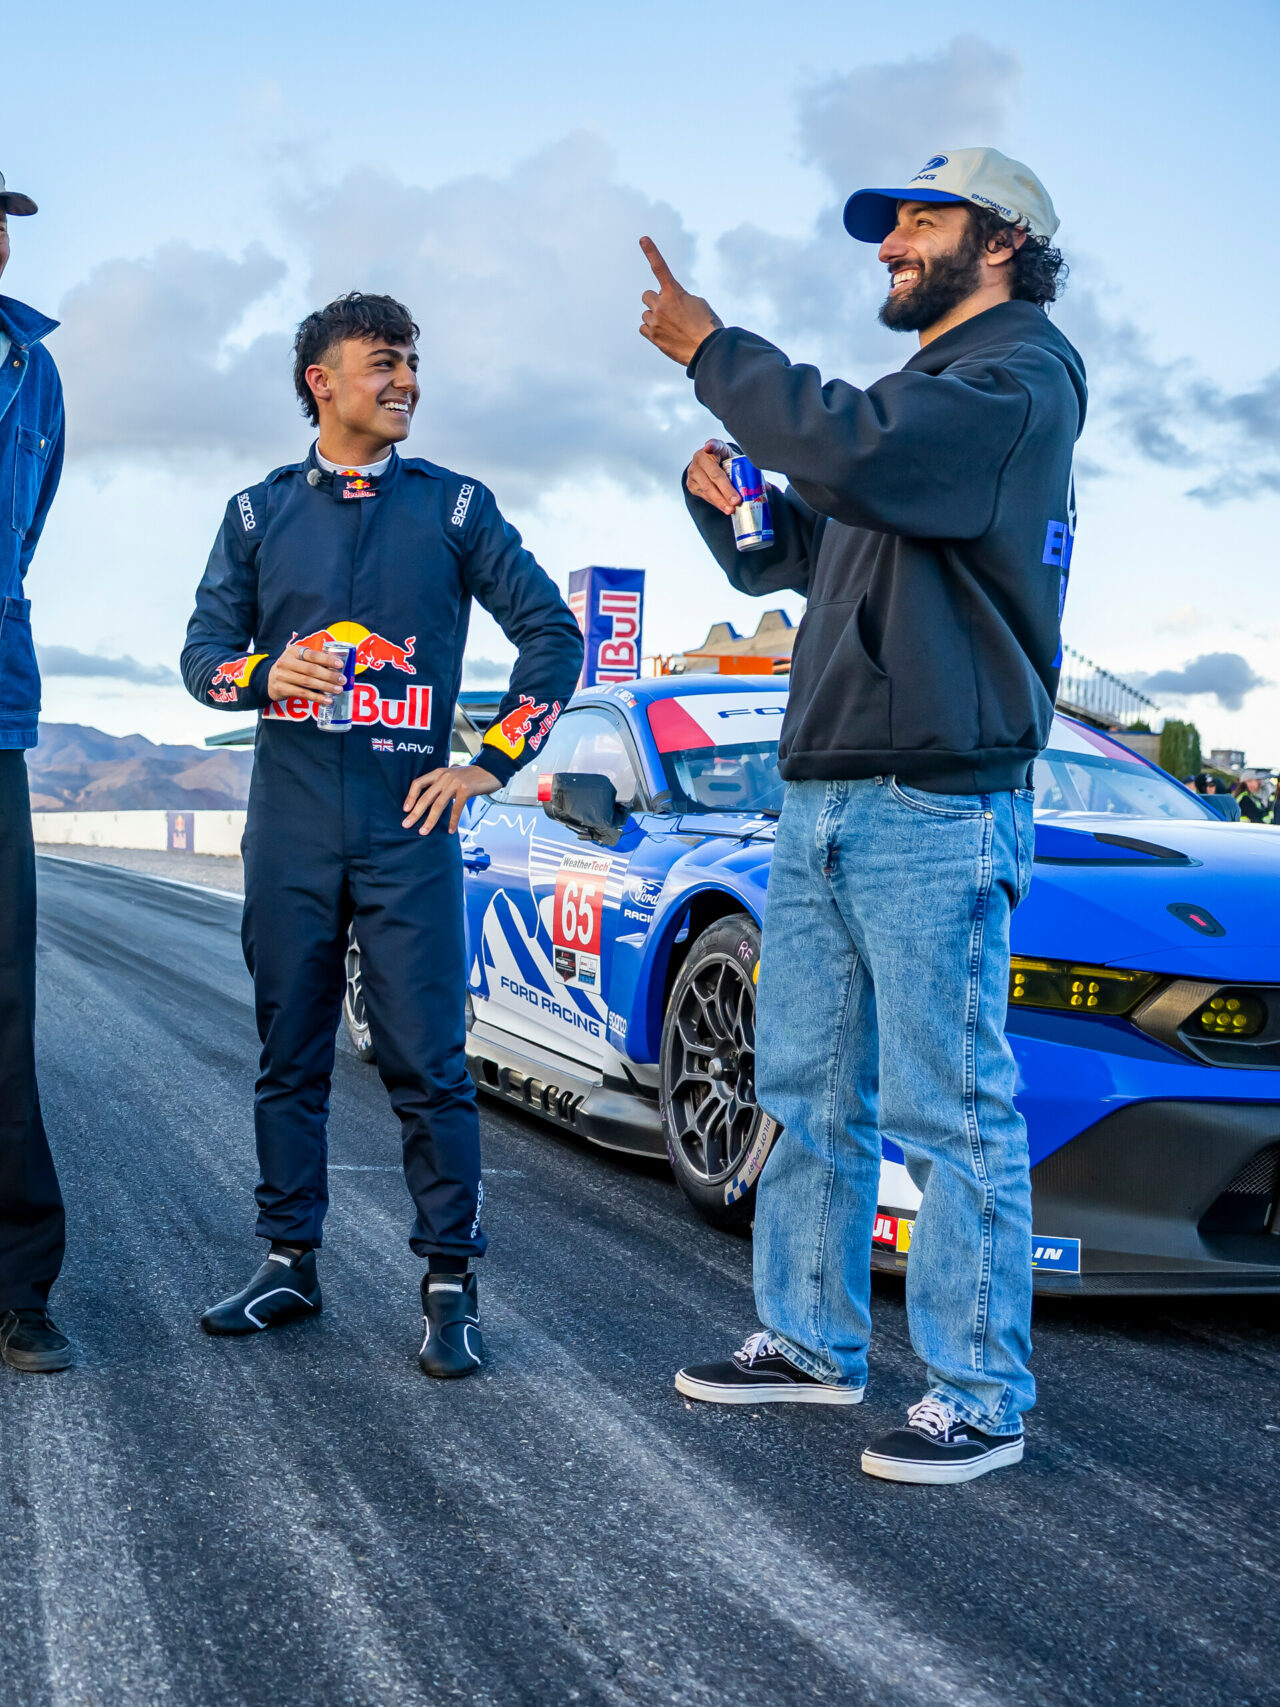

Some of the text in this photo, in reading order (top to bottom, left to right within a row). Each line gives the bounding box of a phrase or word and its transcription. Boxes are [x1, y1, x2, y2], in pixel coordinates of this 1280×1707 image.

[237, 492, 256, 531] sparco
[343, 490, 360, 498] Red
[451, 484, 475, 527] sparco
[600, 594, 637, 667] Bull
[352, 683, 431, 731] Bull
[528, 700, 561, 751] Red Bull
[563, 857, 609, 872] WeatherTech
[561, 881, 595, 945] 65
[634, 882, 662, 905] Ford
[624, 909, 653, 923] RACI
[501, 976, 538, 1006] FORD
[541, 996, 600, 1038] RACING
